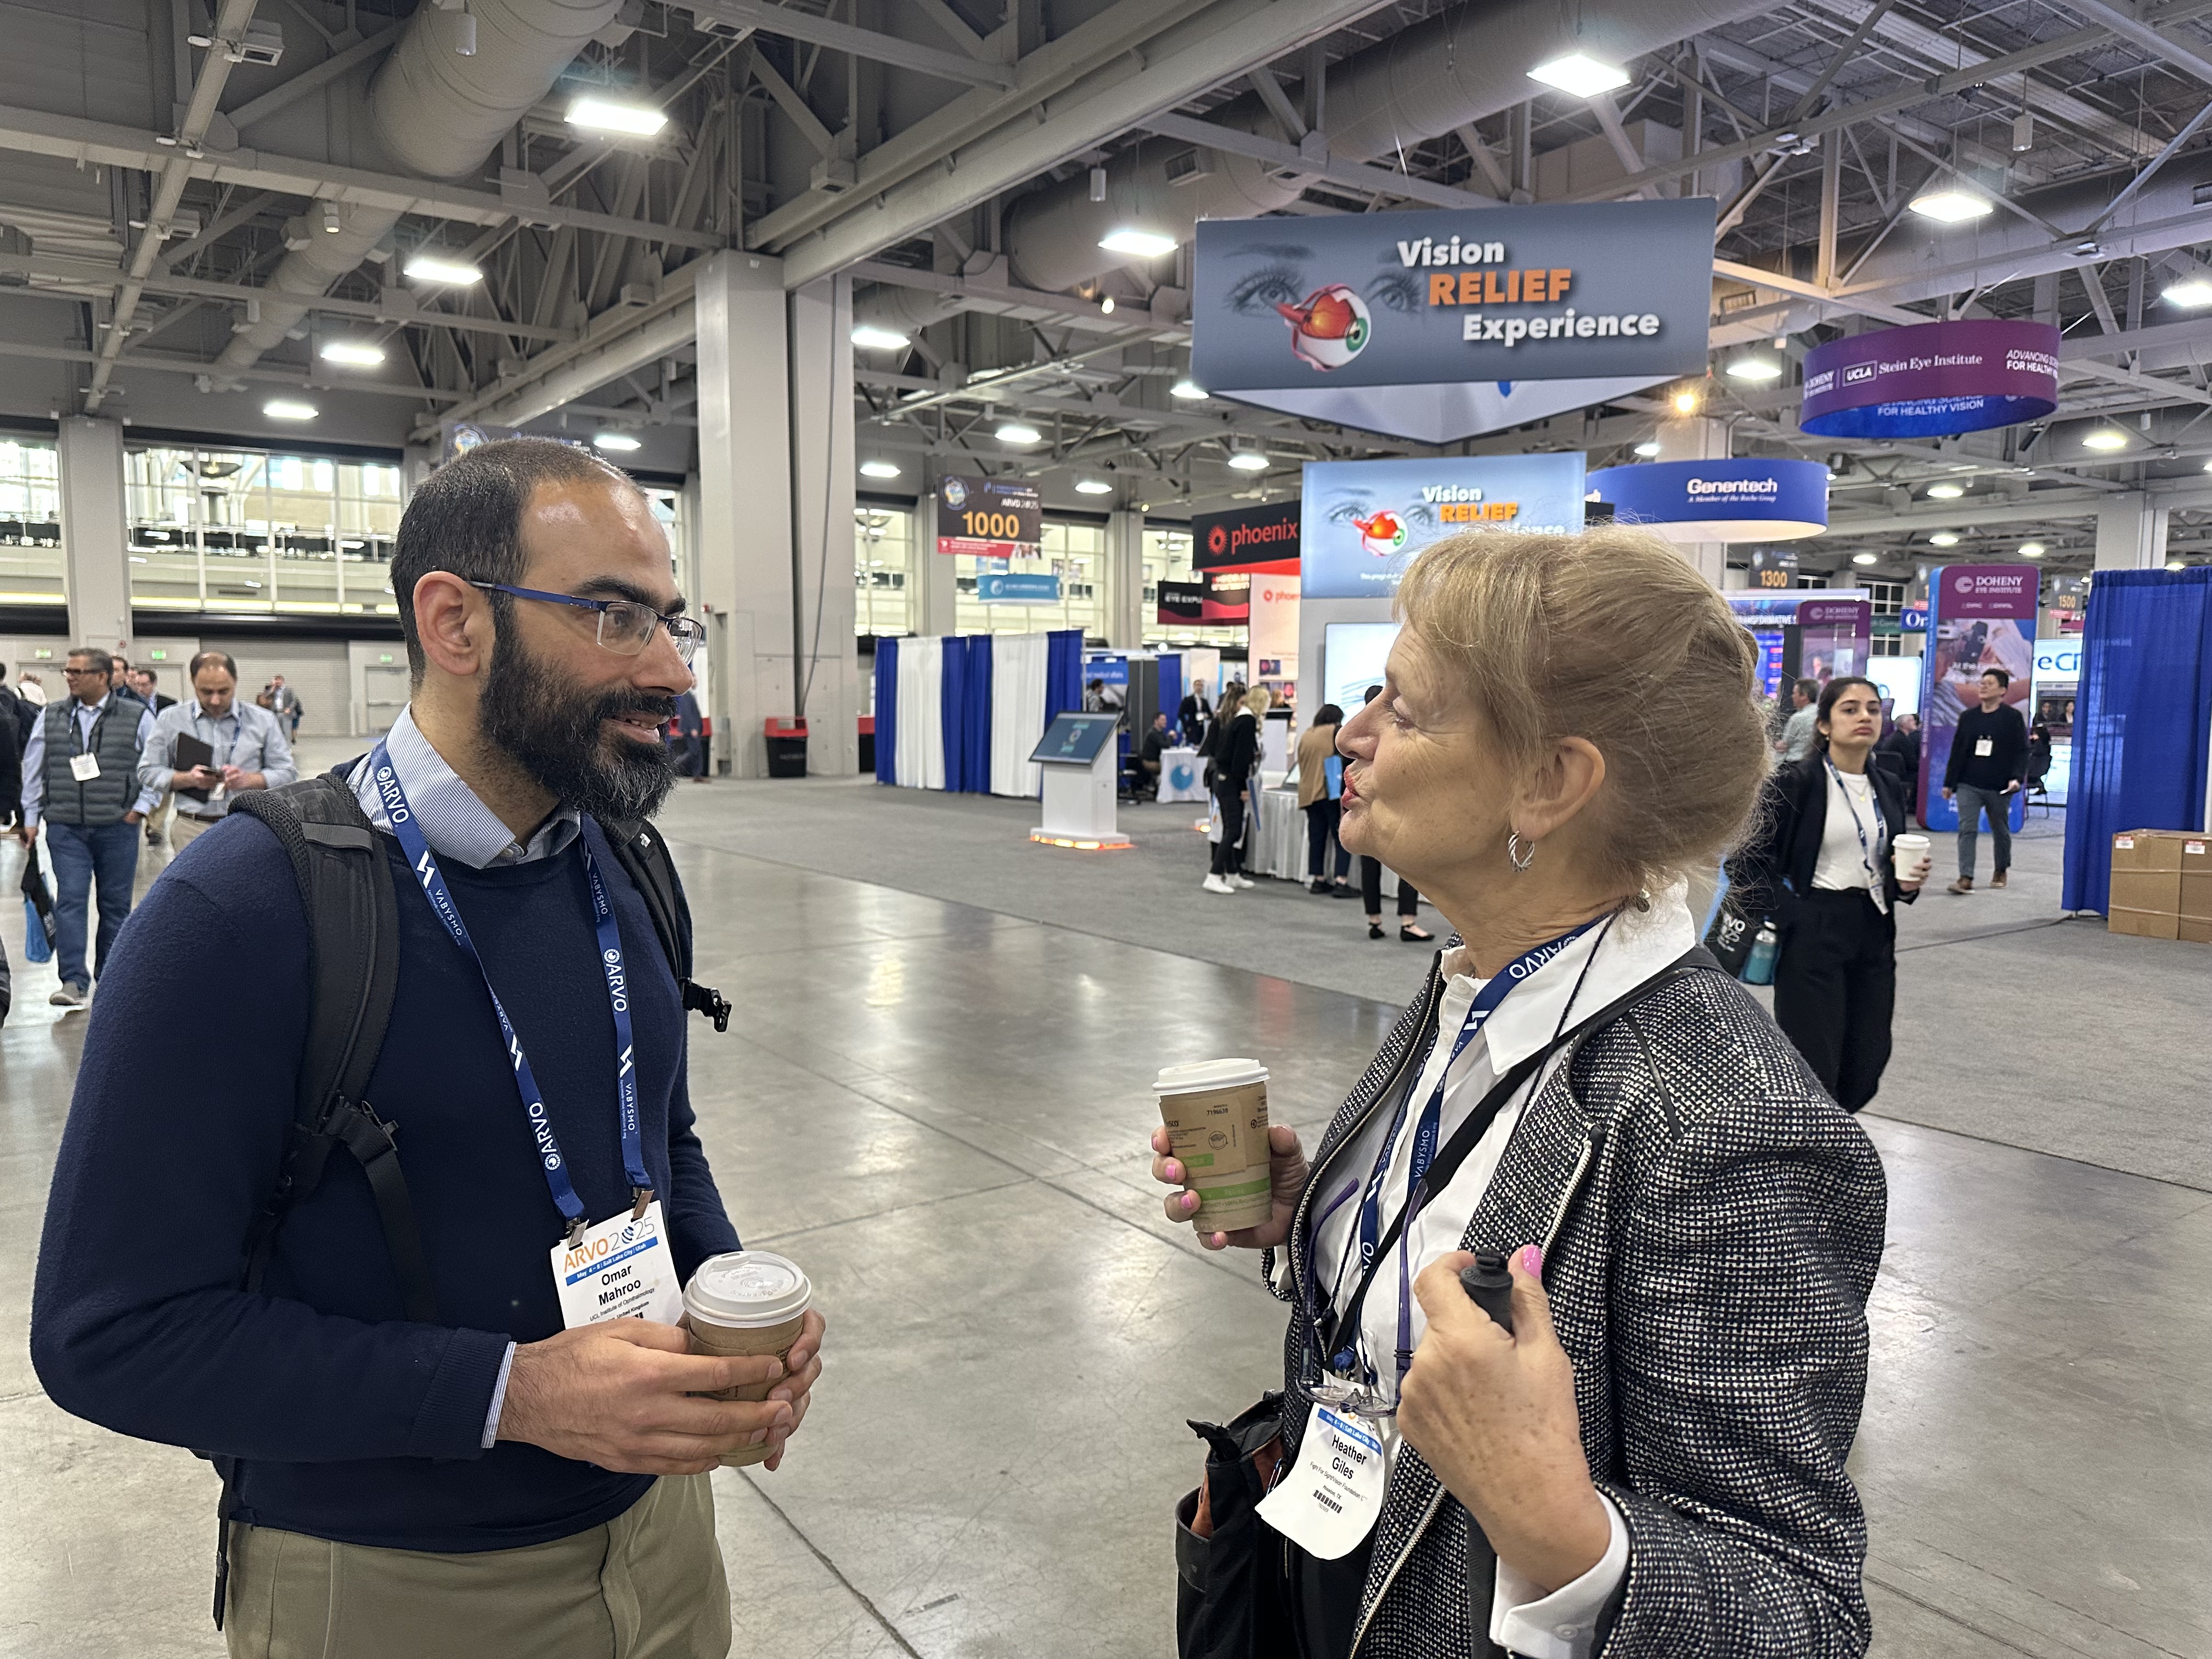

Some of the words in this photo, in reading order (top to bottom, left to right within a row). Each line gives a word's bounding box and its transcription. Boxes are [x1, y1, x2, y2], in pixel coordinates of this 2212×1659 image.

[1397, 235, 1505, 267] Vision
[1429, 269, 1572, 306] RELIEF
[1463, 309, 1659, 347] Experience
[1847, 366, 1872, 381] UCLA
[1878, 361, 1907, 374] Stein
[1910, 358, 1932, 371] Eye
[1934, 353, 1983, 366] Institute
[2006, 349, 2049, 364] ADVANCING
[2007, 360, 2025, 370] FOR
[1877, 407, 1898, 416] FOR
[1901, 404, 1948, 415] HEALTHY
[1950, 399, 1984, 411] VISION
[1421, 484, 1482, 502] Vision
[1687, 477, 1778, 494] Genentech
[962, 510, 1020, 538] 1000
[1440, 502, 1517, 522] RELIEF
[1231, 517, 1299, 555] phoenix
[1760, 569, 1788, 588] 1300
[1976, 575, 2023, 586] DOHENY
[2059, 595, 2076, 608] 1500
[379, 780, 409, 823] ARVO
[593, 873, 608, 915] VABYSMO
[435, 889, 462, 936] VABYSMO
[606, 963, 628, 1012] ARVO
[625, 1083, 636, 1131] VABYSMO
[529, 1102, 557, 1153] ARVO
[1414, 1130, 1430, 1178] VABYSMO
[564, 1238, 608, 1273] ARVO
[609, 1216, 654, 1251] 2025
[603, 1258, 613, 1266] Salt
[612, 1254, 624, 1262] Lake
[635, 1243, 646, 1251] Utah
[601, 1265, 632, 1286] Omar
[598, 1279, 641, 1306] Mahroo
[590, 1313, 600, 1321] UCL
[617, 1309, 630, 1318] United
[1332, 1434, 1367, 1465] Heather
[1332, 1457, 1354, 1480] Giles
